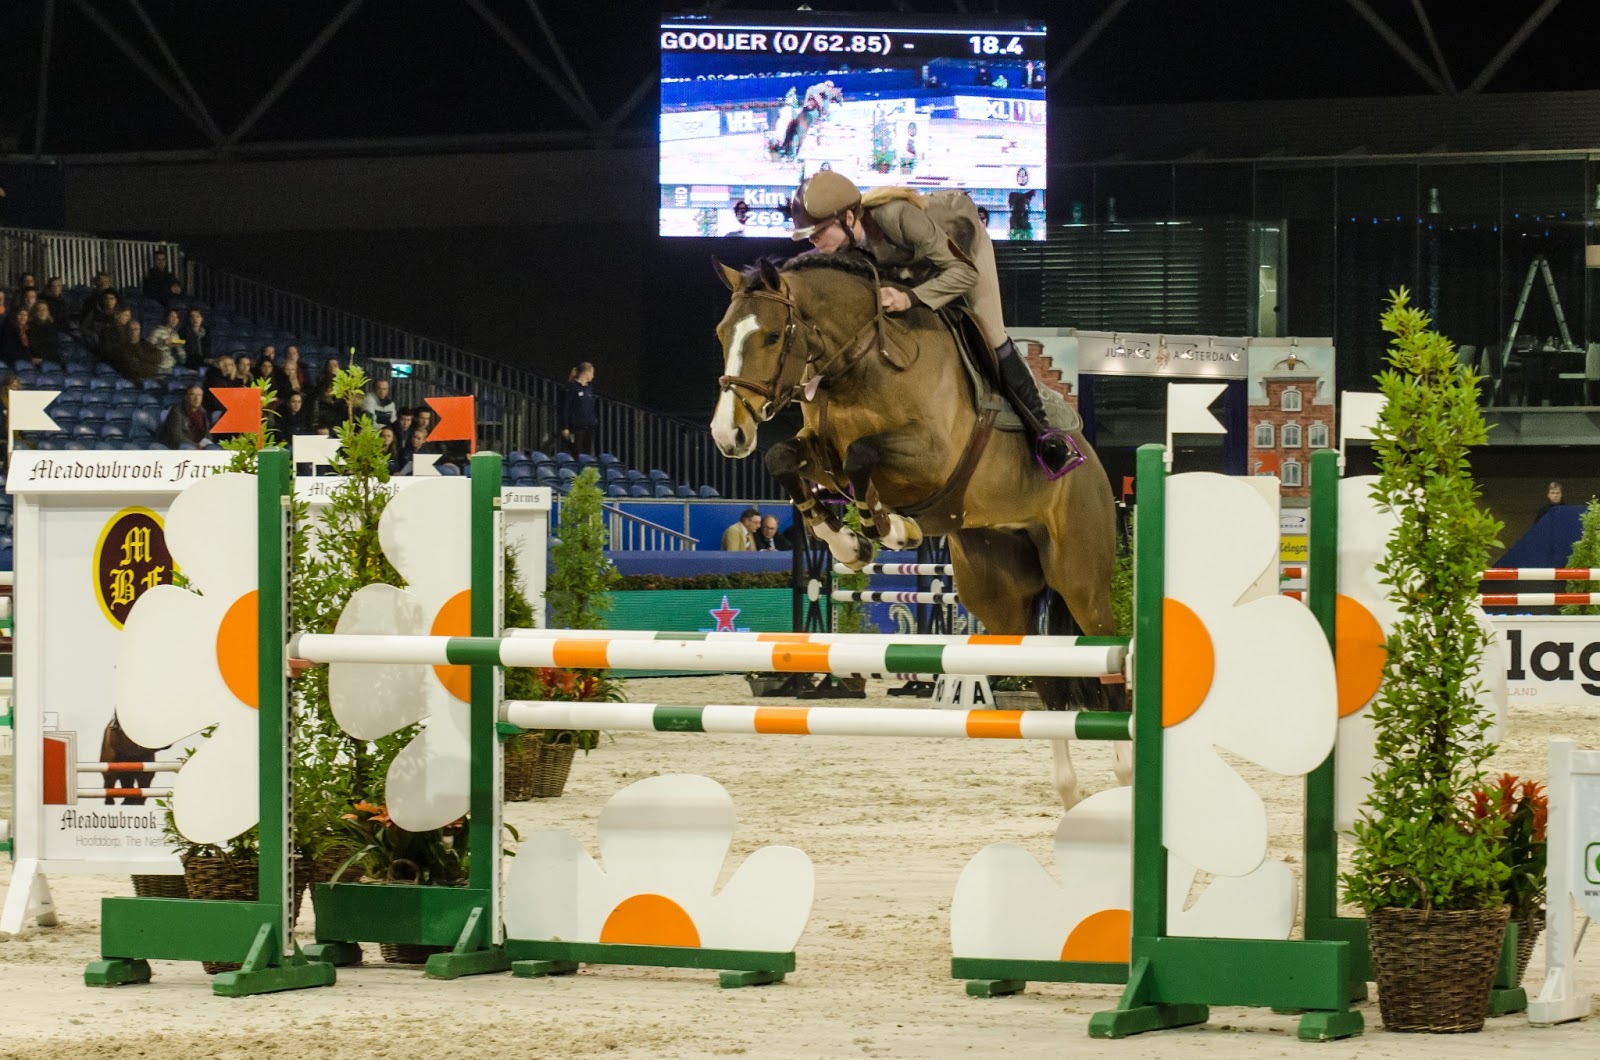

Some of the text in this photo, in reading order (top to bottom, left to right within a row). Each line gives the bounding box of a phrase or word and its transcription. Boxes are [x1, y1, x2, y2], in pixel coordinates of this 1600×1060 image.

[661, 32, 767, 50] GOOIJER
[773, 32, 891, 55] (0/62.85)
[969, 36, 1023, 54] 18.4
[744, 189, 785, 205] Kim
[745, 212, 784, 226] 269
[29, 459, 163, 480] Meadowbrook
[502, 491, 540, 504] Farms
[973, 681, 986, 704] A
[60, 809, 157, 830] Meadowbrook
[125, 836, 141, 847] The
